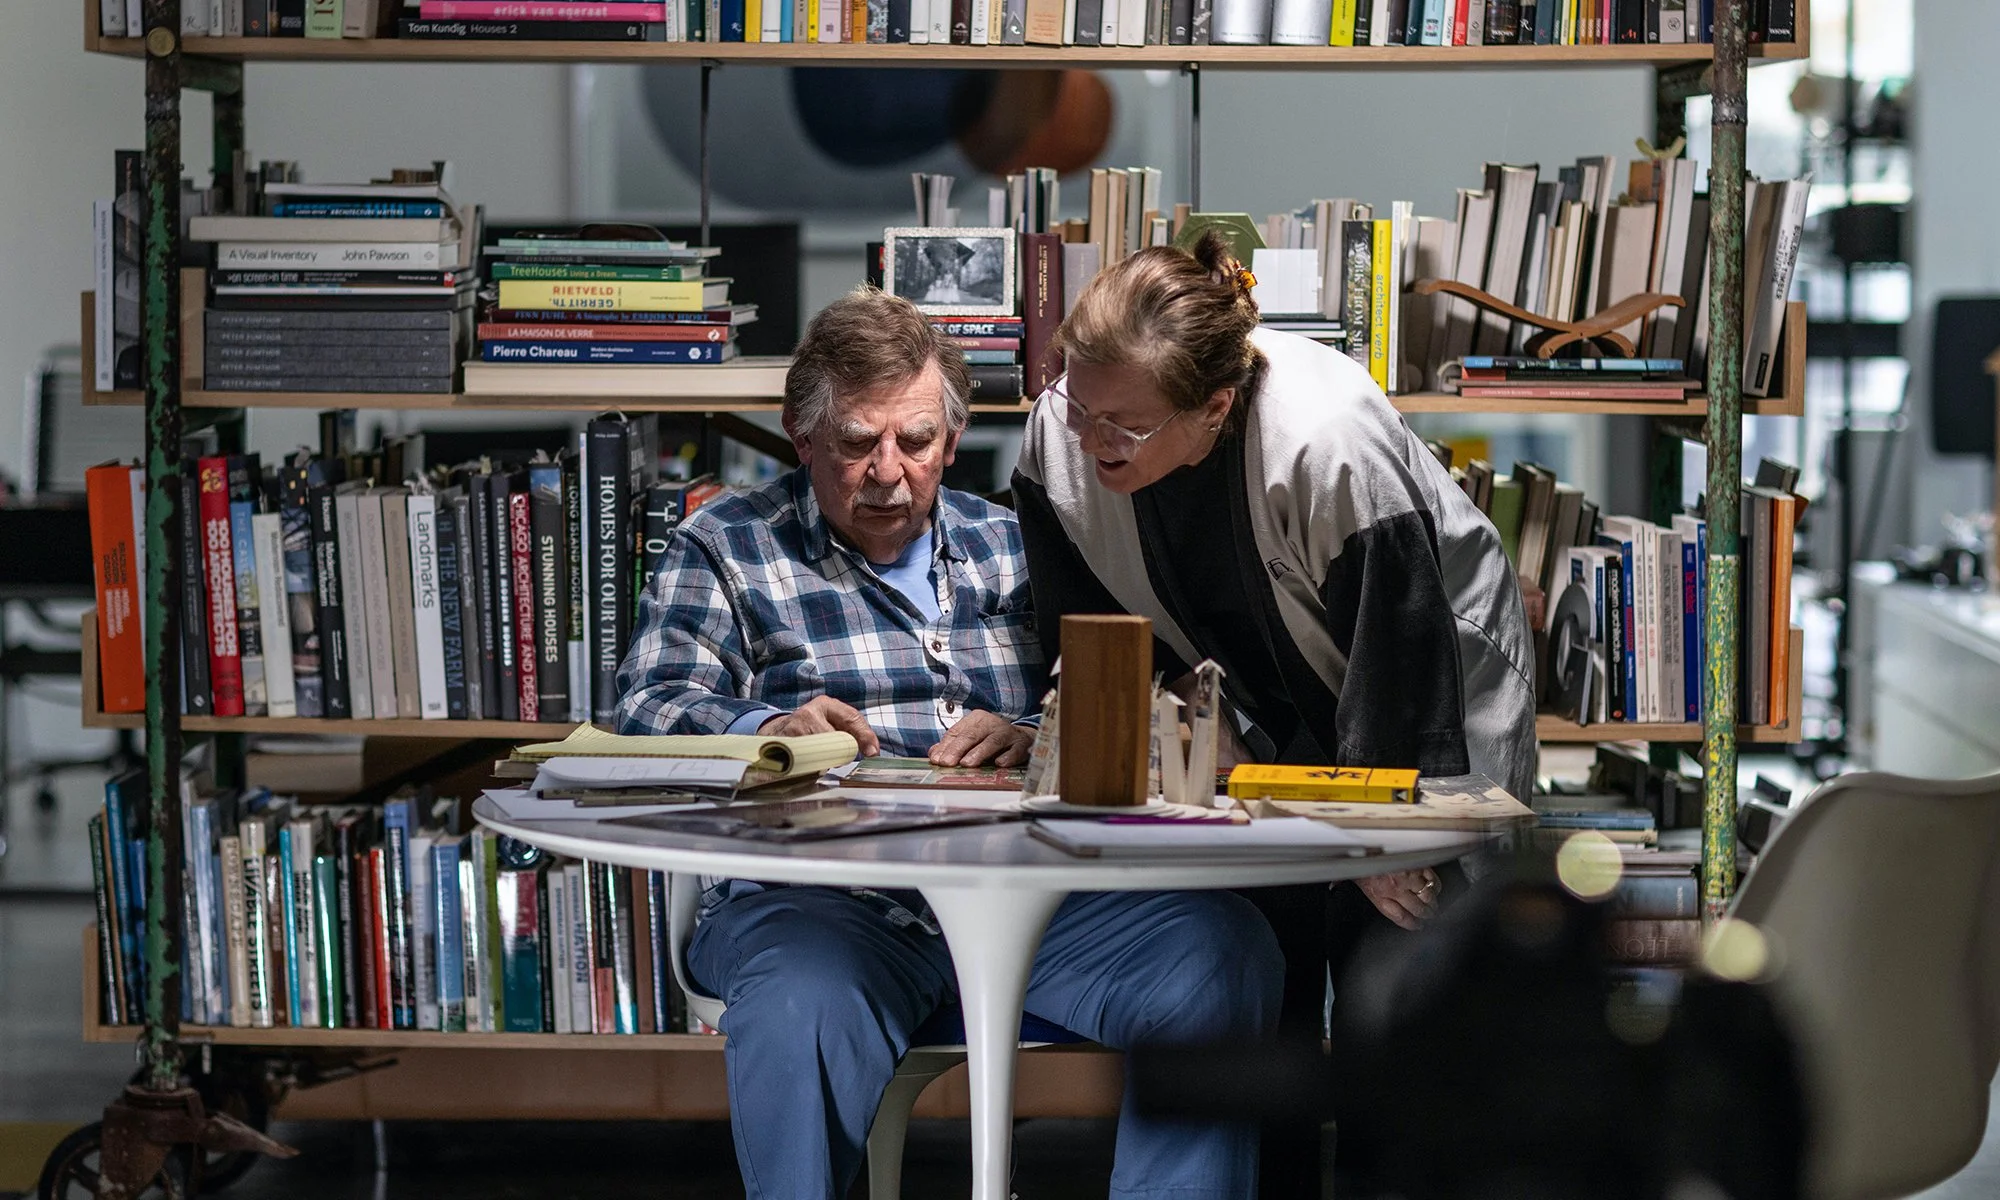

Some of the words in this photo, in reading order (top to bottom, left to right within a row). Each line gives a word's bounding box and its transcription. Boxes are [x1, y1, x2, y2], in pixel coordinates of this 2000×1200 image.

[408, 23, 430, 33] Tom
[431, 23, 466, 36] Kundig
[471, 24, 507, 34] Houses
[510, 24, 517, 34] 2
[531, 7, 554, 17] van
[229, 250, 238, 260] A
[239, 249, 268, 260] Visual
[270, 249, 317, 262] Inventory
[341, 249, 367, 261] John
[369, 250, 409, 261] Pawson
[510, 266, 567, 277] TreeHouses
[553, 286, 614, 296] RIETVELD
[570, 298, 614, 308] GERRIT
[1353, 288, 1365, 325] FROM
[508, 328, 520, 338] LA
[520, 329, 553, 338] MAISON
[554, 329, 566, 338] DE
[567, 329, 594, 338] VERRE
[948, 324, 960, 334] OF
[962, 324, 995, 335] SPACE
[1374, 333, 1385, 359] verb
[492, 345, 527, 357] Pierre
[529, 346, 578, 357] Chareau
[321, 496, 332, 532] Houses
[568, 485, 579, 519] LONG
[600, 475, 616, 540] HOMES
[207, 518, 218, 549] 100
[219, 518, 230, 549] 100
[479, 492, 489, 565] SCANDINAVIAN
[496, 497, 507, 575] SCANDINAVIAN
[515, 495, 528, 553] CHICAGO
[570, 522, 580, 562] ISLAND
[417, 511, 436, 609] Landmarks
[440, 541, 457, 582] THE
[540, 536, 554, 607] STUNNING
[600, 544, 616, 580] FOR
[209, 551, 225, 657] ARCHITECTS
[220, 550, 235, 619] HOUSES
[483, 569, 492, 610] MODERN
[501, 578, 510, 622] MODERN
[517, 557, 532, 640] ARCHITECTURE
[600, 582, 617, 622] OUR
[1611, 569, 1620, 608] modern
[442, 586, 459, 634] NEW
[225, 622, 238, 656] FOR
[485, 613, 493, 651] HOUSES
[502, 625, 512, 666] HOUSES
[543, 611, 558, 663] HOUSES
[601, 623, 617, 672] TIME
[1611, 608, 1621, 662] architecture
[445, 634, 463, 688] FARM
[521, 644, 533, 672] AND
[523, 675, 536, 720] DESIGN
[574, 922, 587, 984] NATION
